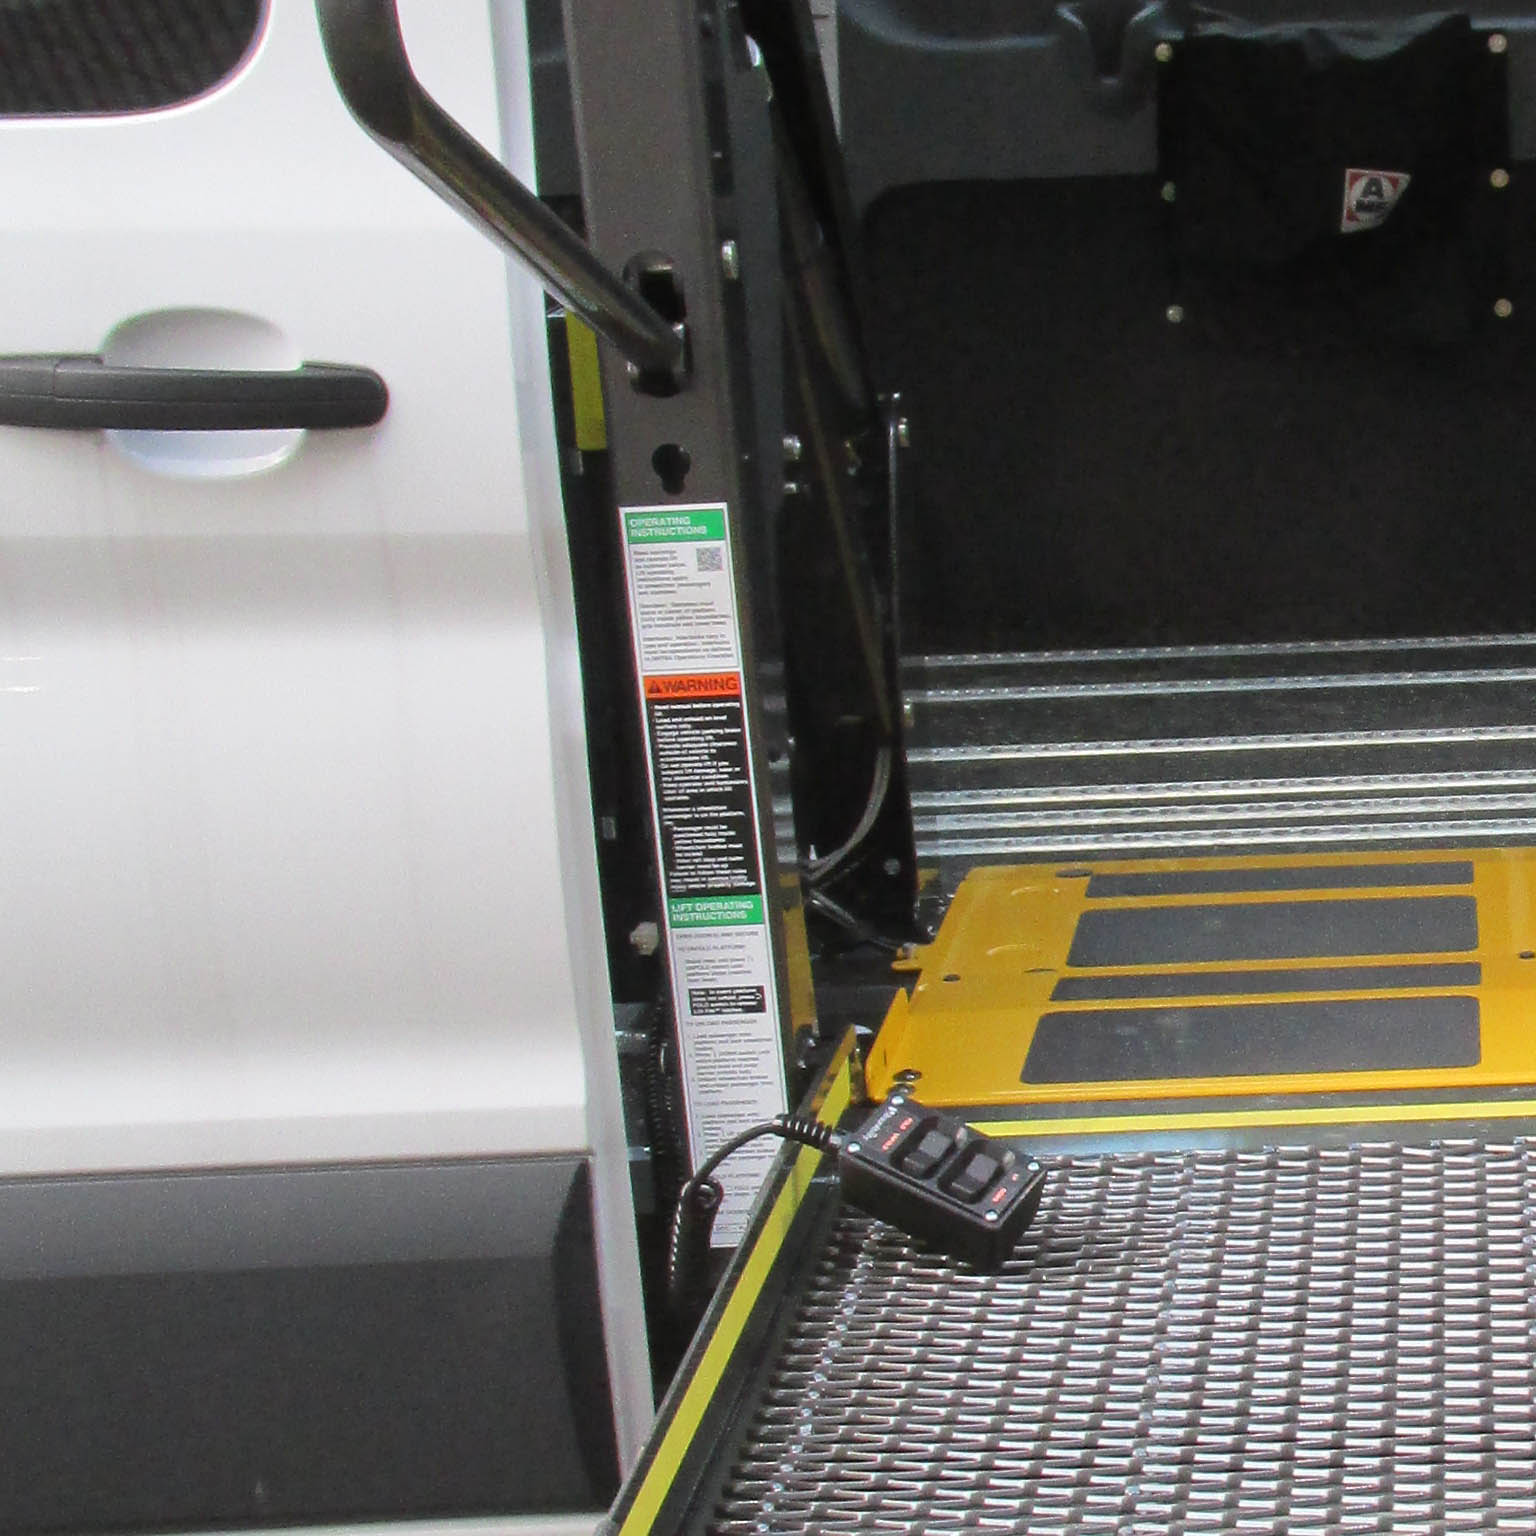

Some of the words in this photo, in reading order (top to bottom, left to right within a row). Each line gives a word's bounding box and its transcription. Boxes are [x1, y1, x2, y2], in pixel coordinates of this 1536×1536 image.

[629, 515, 692, 528] OPERATING
[630, 525, 708, 538] INSTRUCTIONS
[663, 676, 739, 694] WARNING
[672, 902, 693, 913] LIFT
[695, 900, 754, 912] OPERATING
[672, 910, 748, 922] INSTRUCTIONS
